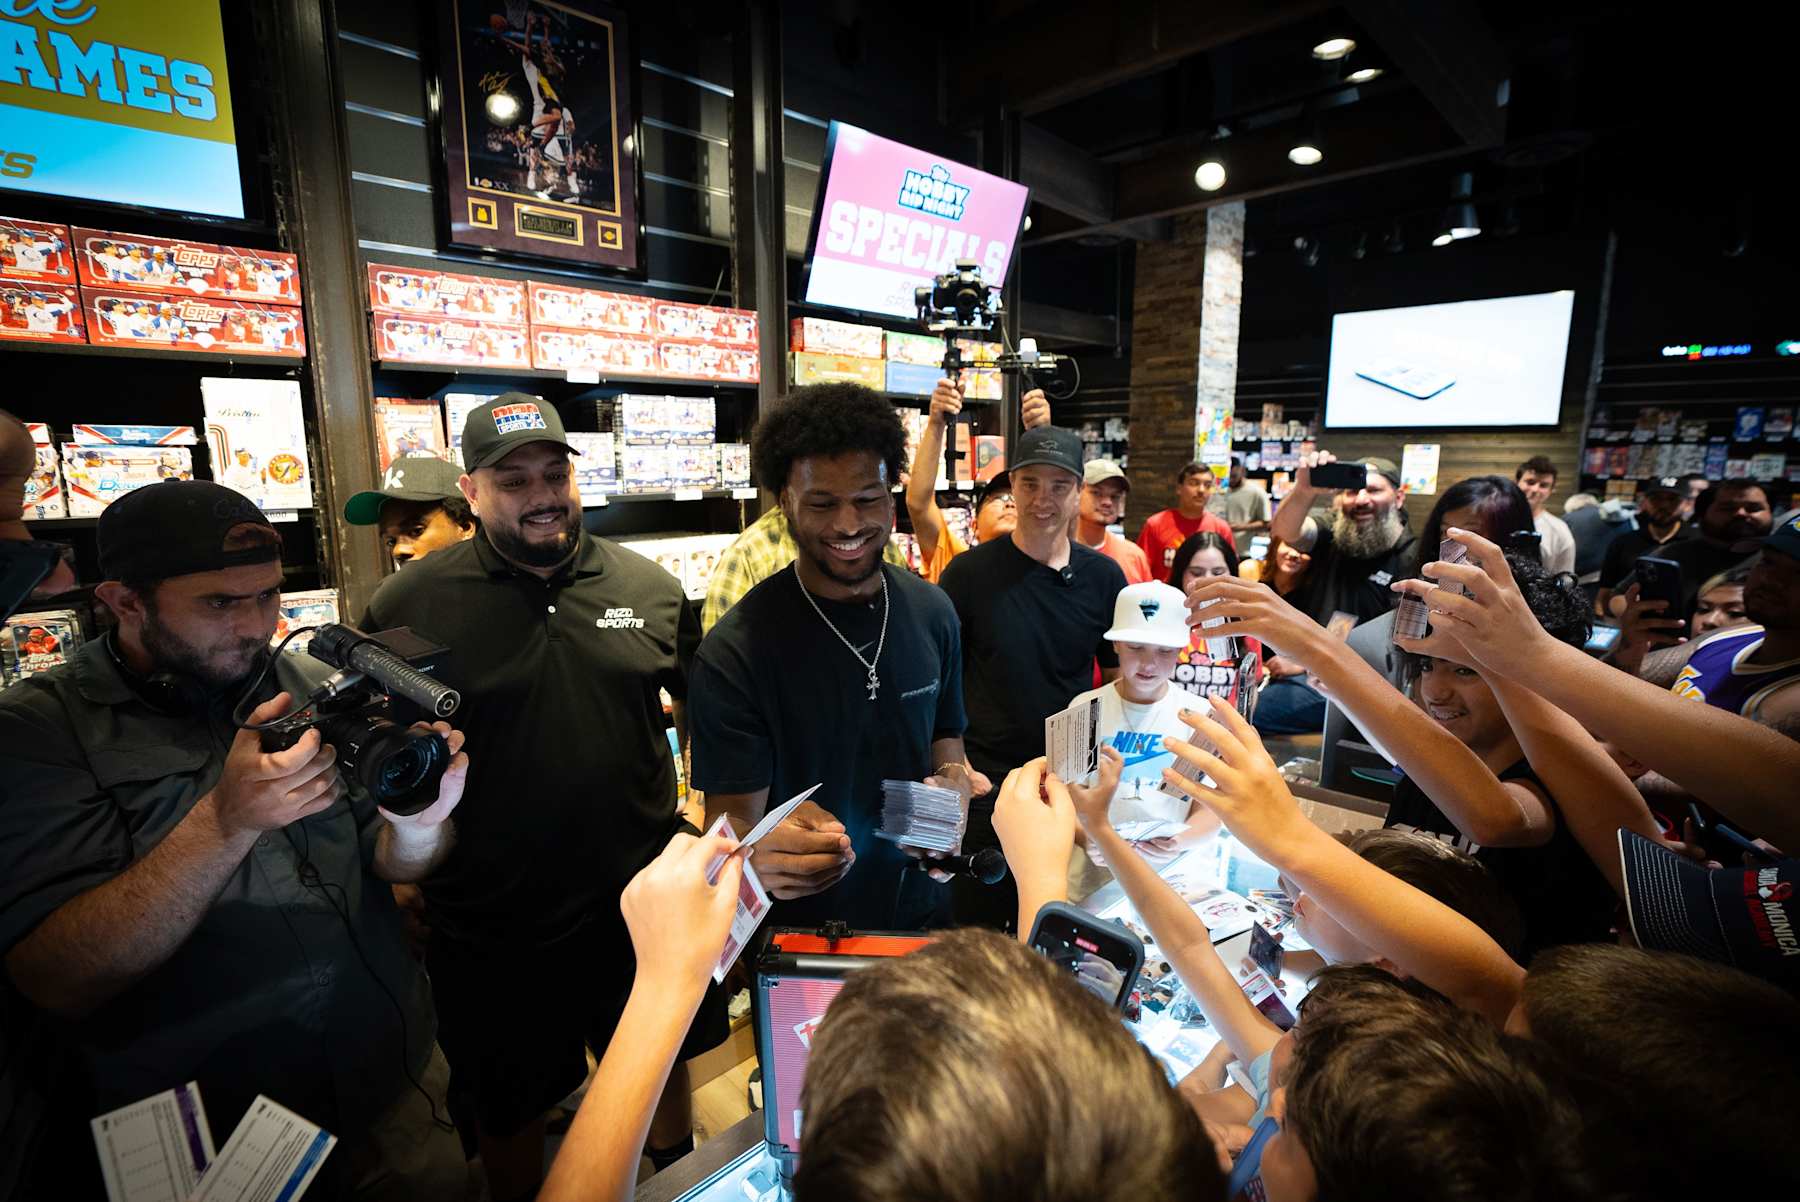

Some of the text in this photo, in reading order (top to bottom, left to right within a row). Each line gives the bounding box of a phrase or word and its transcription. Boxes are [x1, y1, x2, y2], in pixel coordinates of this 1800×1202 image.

[0, 152, 38, 179] S
[904, 172, 968, 204] HOBBY
[923, 198, 963, 220] NIGHT
[595, 618, 645, 629] SPORTS
[1112, 731, 1163, 755] NIKE
[1762, 902, 1800, 956] MONICA
